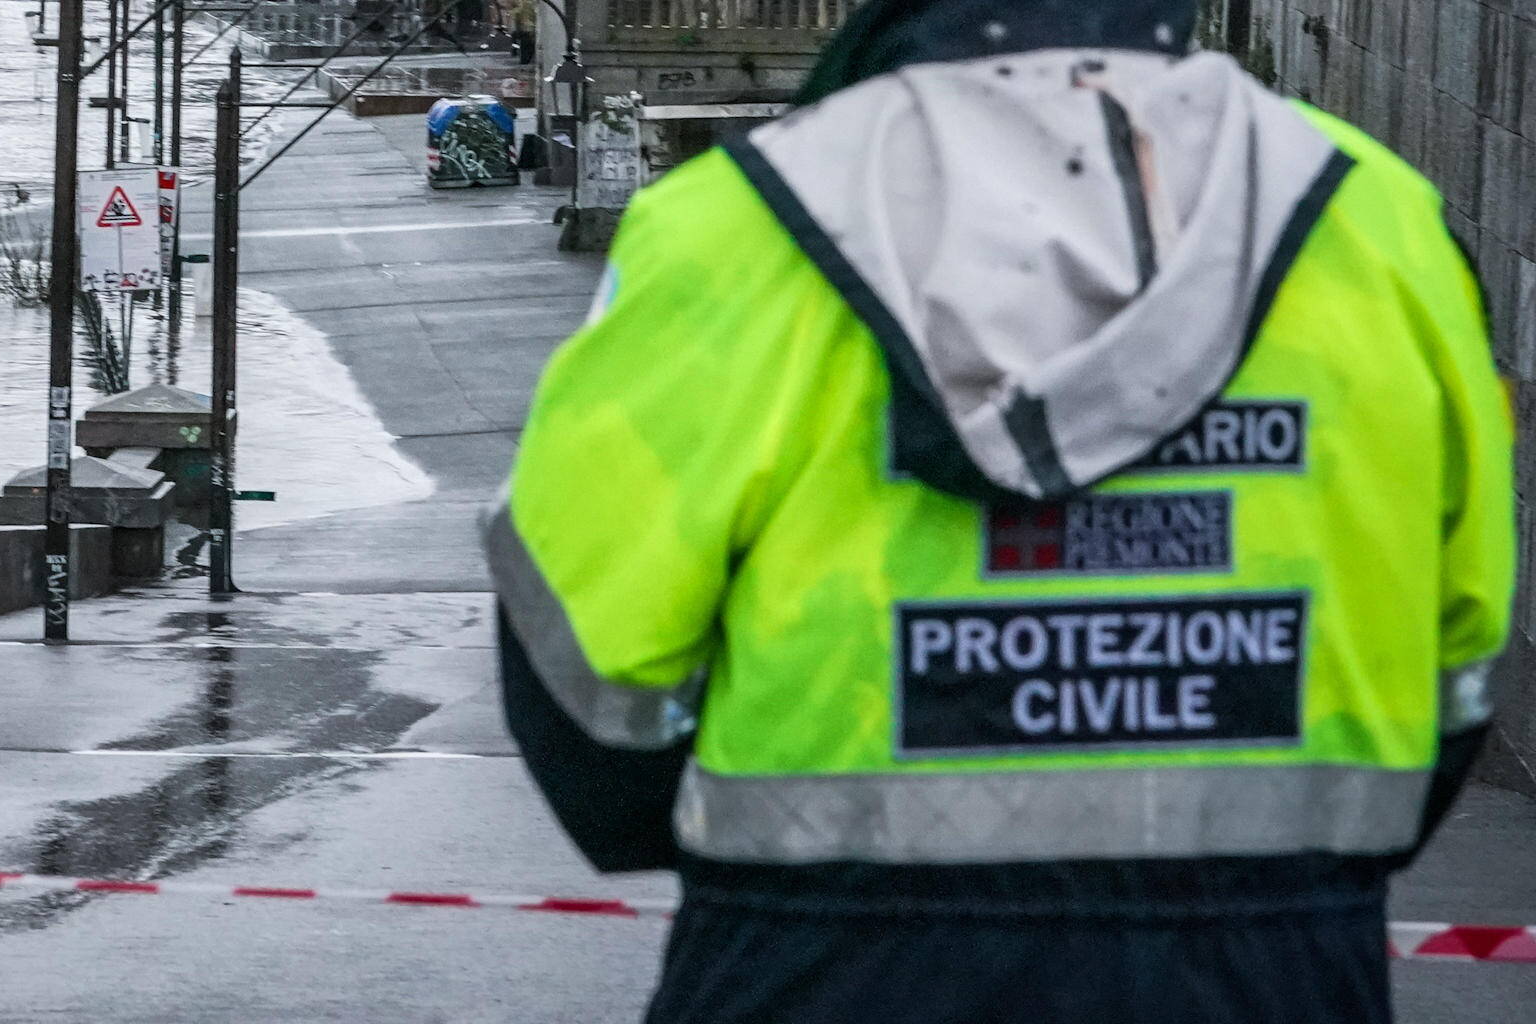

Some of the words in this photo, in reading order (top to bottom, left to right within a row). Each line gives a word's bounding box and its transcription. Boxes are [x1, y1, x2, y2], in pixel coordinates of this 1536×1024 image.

[1066, 494, 1227, 532] REGIONE
[909, 607, 1298, 675] PROTEZIONE
[1011, 674, 1218, 735] CIVILE
